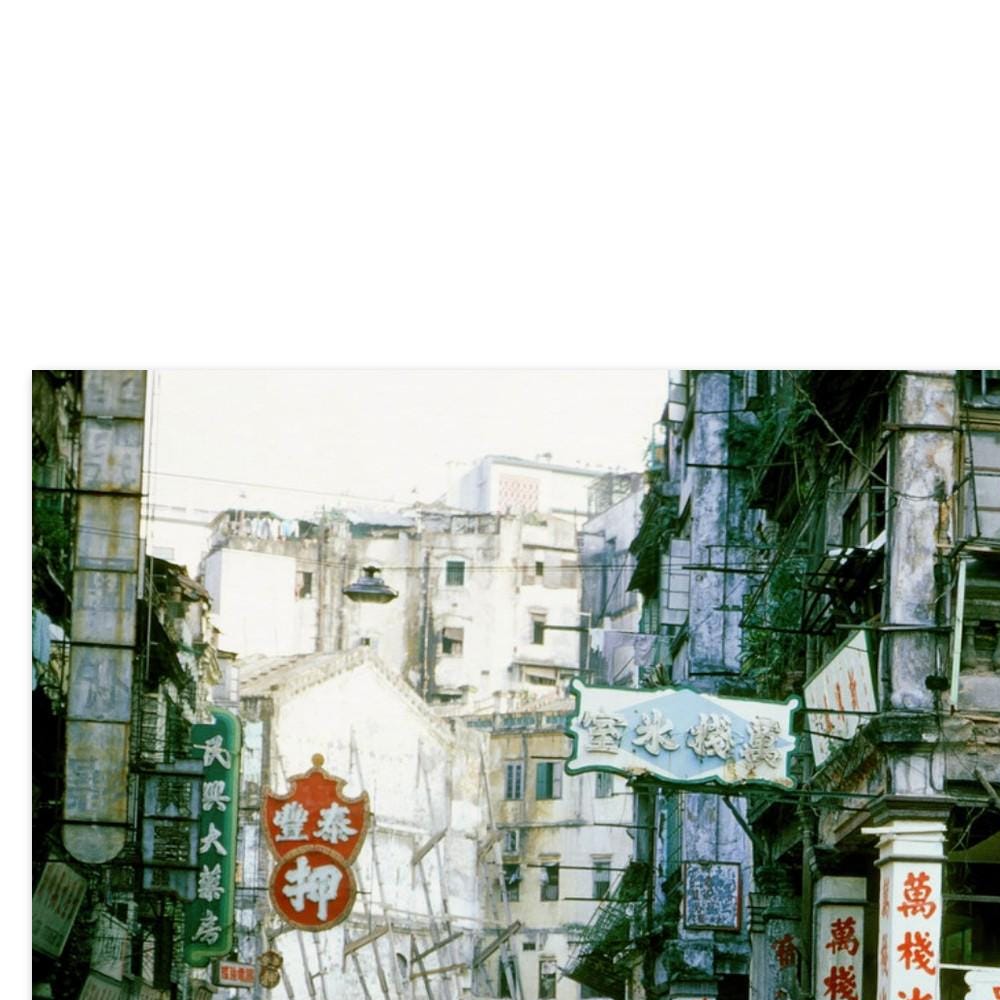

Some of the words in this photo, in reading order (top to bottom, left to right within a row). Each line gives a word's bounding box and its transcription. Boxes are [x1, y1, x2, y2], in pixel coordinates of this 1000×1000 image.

[580, 708, 782, 769] 萬棧冰室
[273, 801, 357, 843] 泰豐
[282, 855, 343, 921] 押
